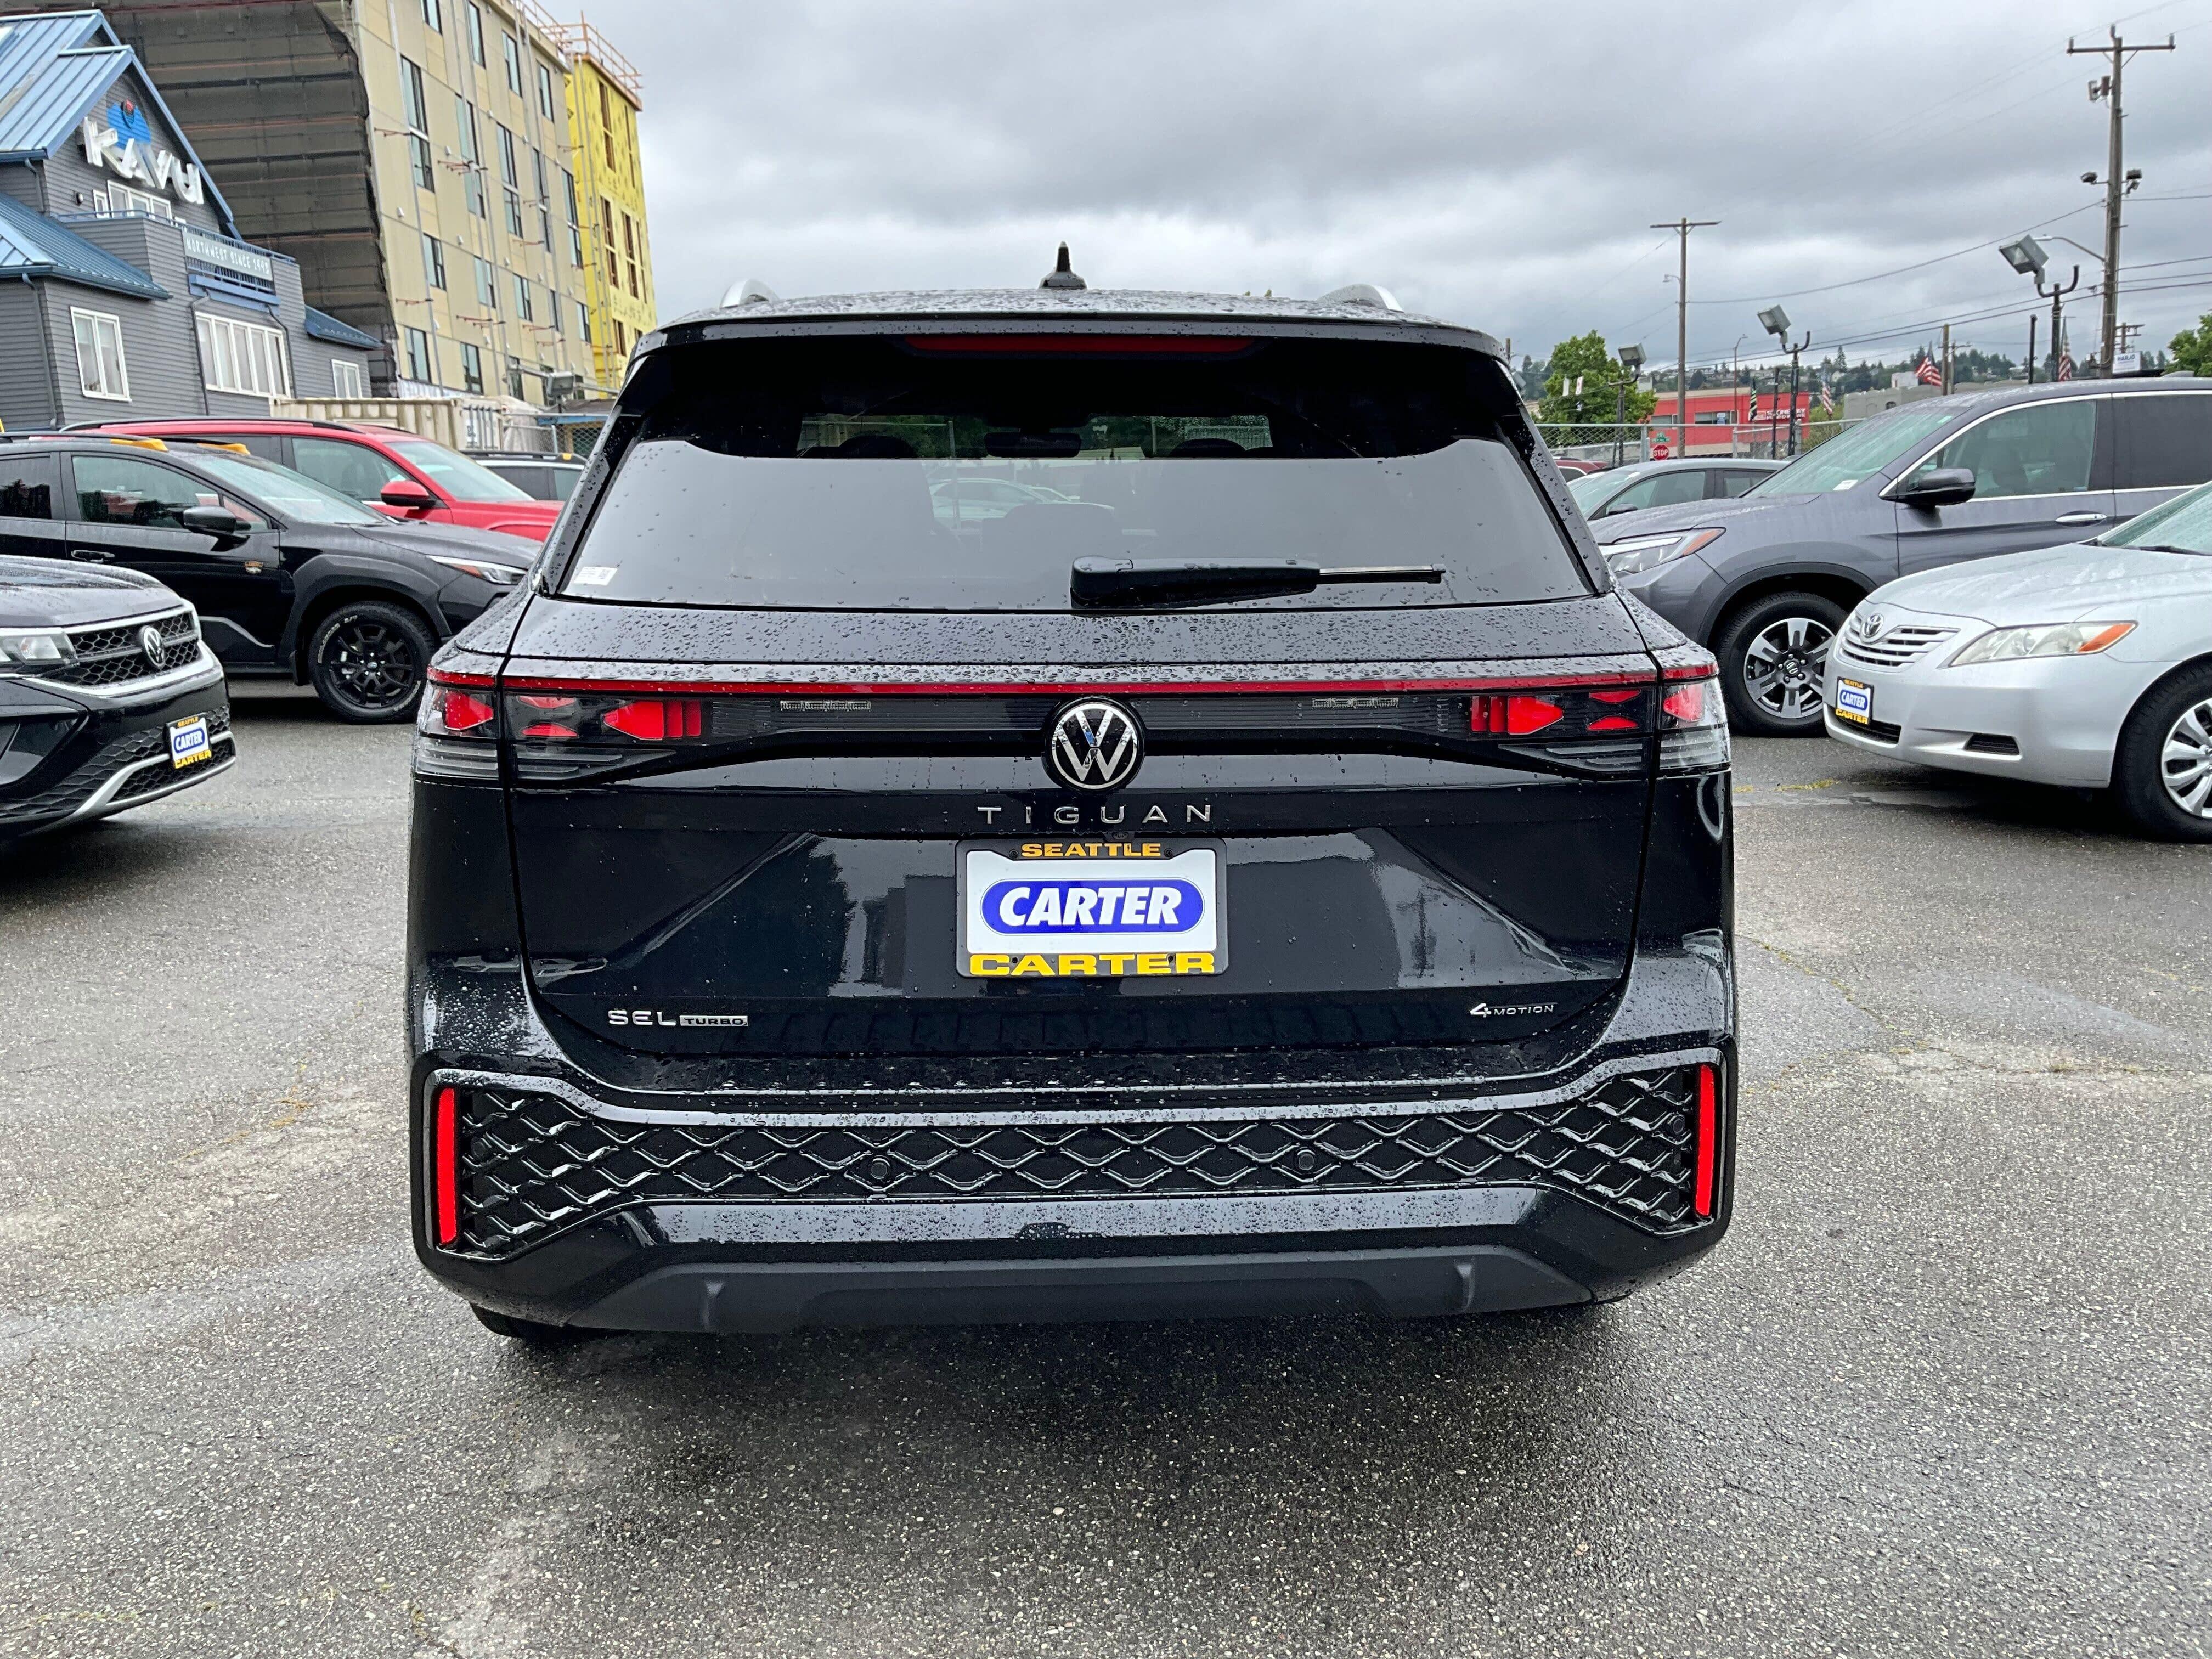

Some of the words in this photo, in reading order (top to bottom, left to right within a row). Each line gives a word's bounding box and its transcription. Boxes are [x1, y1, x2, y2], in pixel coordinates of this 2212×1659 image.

[187, 238, 227, 261] NORTHWEST
[230, 251, 251, 269] SINCE
[1841, 691, 1866, 708] CARTER
[1836, 708, 1868, 725] CARTER
[176, 730, 202, 751] CARTER
[175, 750, 211, 769] CARTER
[977, 804, 1211, 825] TIGUAN
[1022, 843, 1161, 857] SEATTLE
[999, 887, 1182, 927] CARTER
[969, 952, 1215, 976] CARTER
[608, 1010, 676, 1026] SEL
